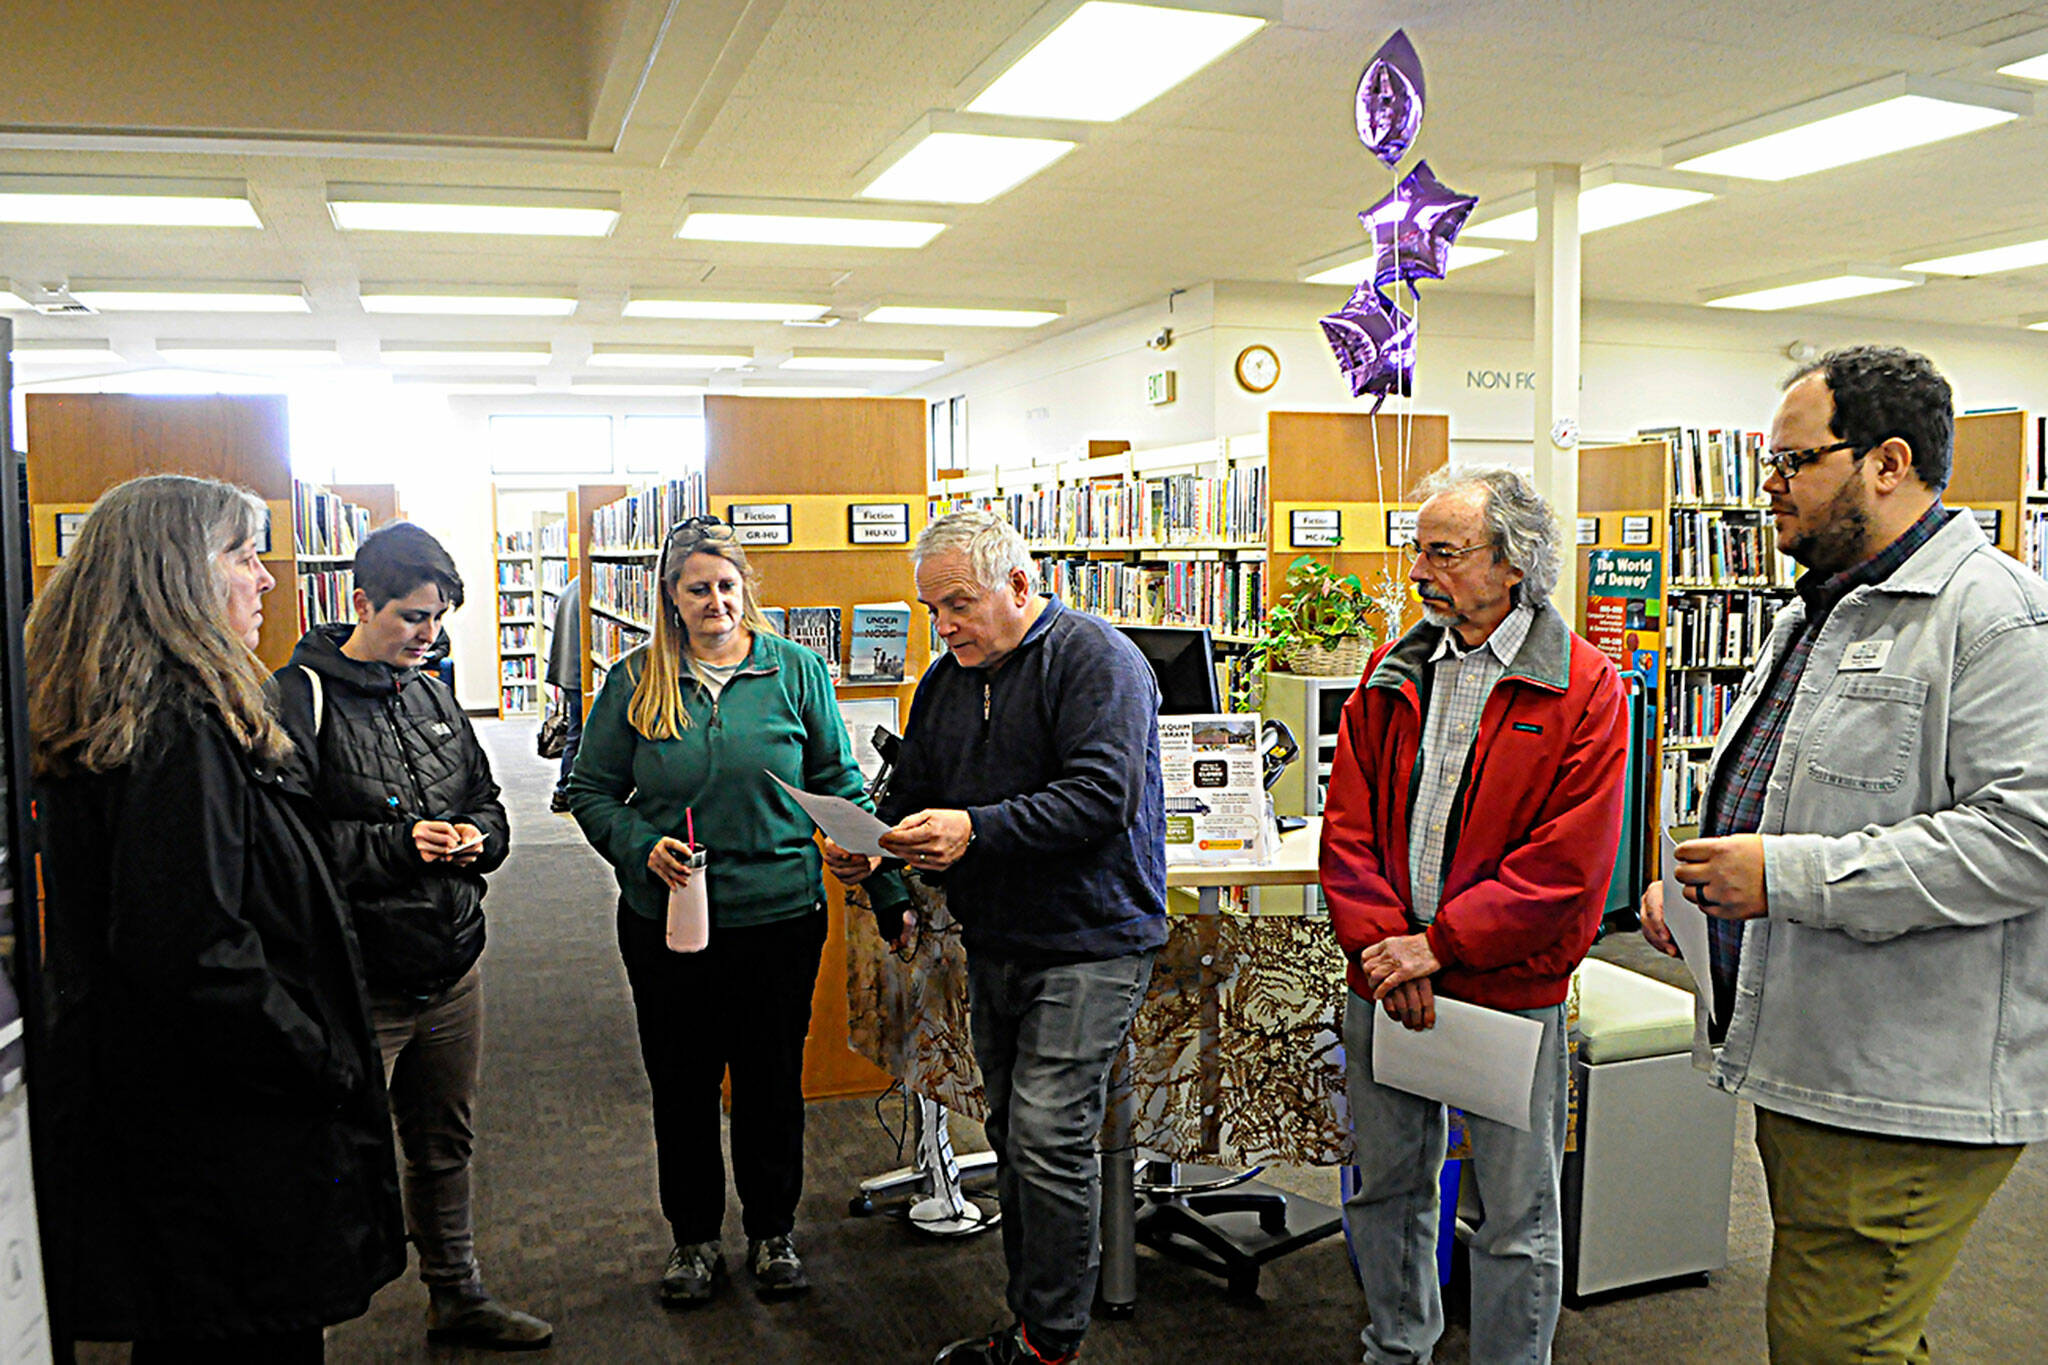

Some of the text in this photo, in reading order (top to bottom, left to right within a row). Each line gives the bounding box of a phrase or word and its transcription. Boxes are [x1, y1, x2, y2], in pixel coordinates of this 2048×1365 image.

[1467, 371, 1510, 388] NON
[744, 512, 776, 520] Fiction
[863, 512, 894, 520] Fiction
[746, 531, 779, 539] GR-HU
[1597, 558, 1652, 572] The World
[1595, 572, 1648, 590] of Dewey
[866, 616, 898, 624] UNDER
